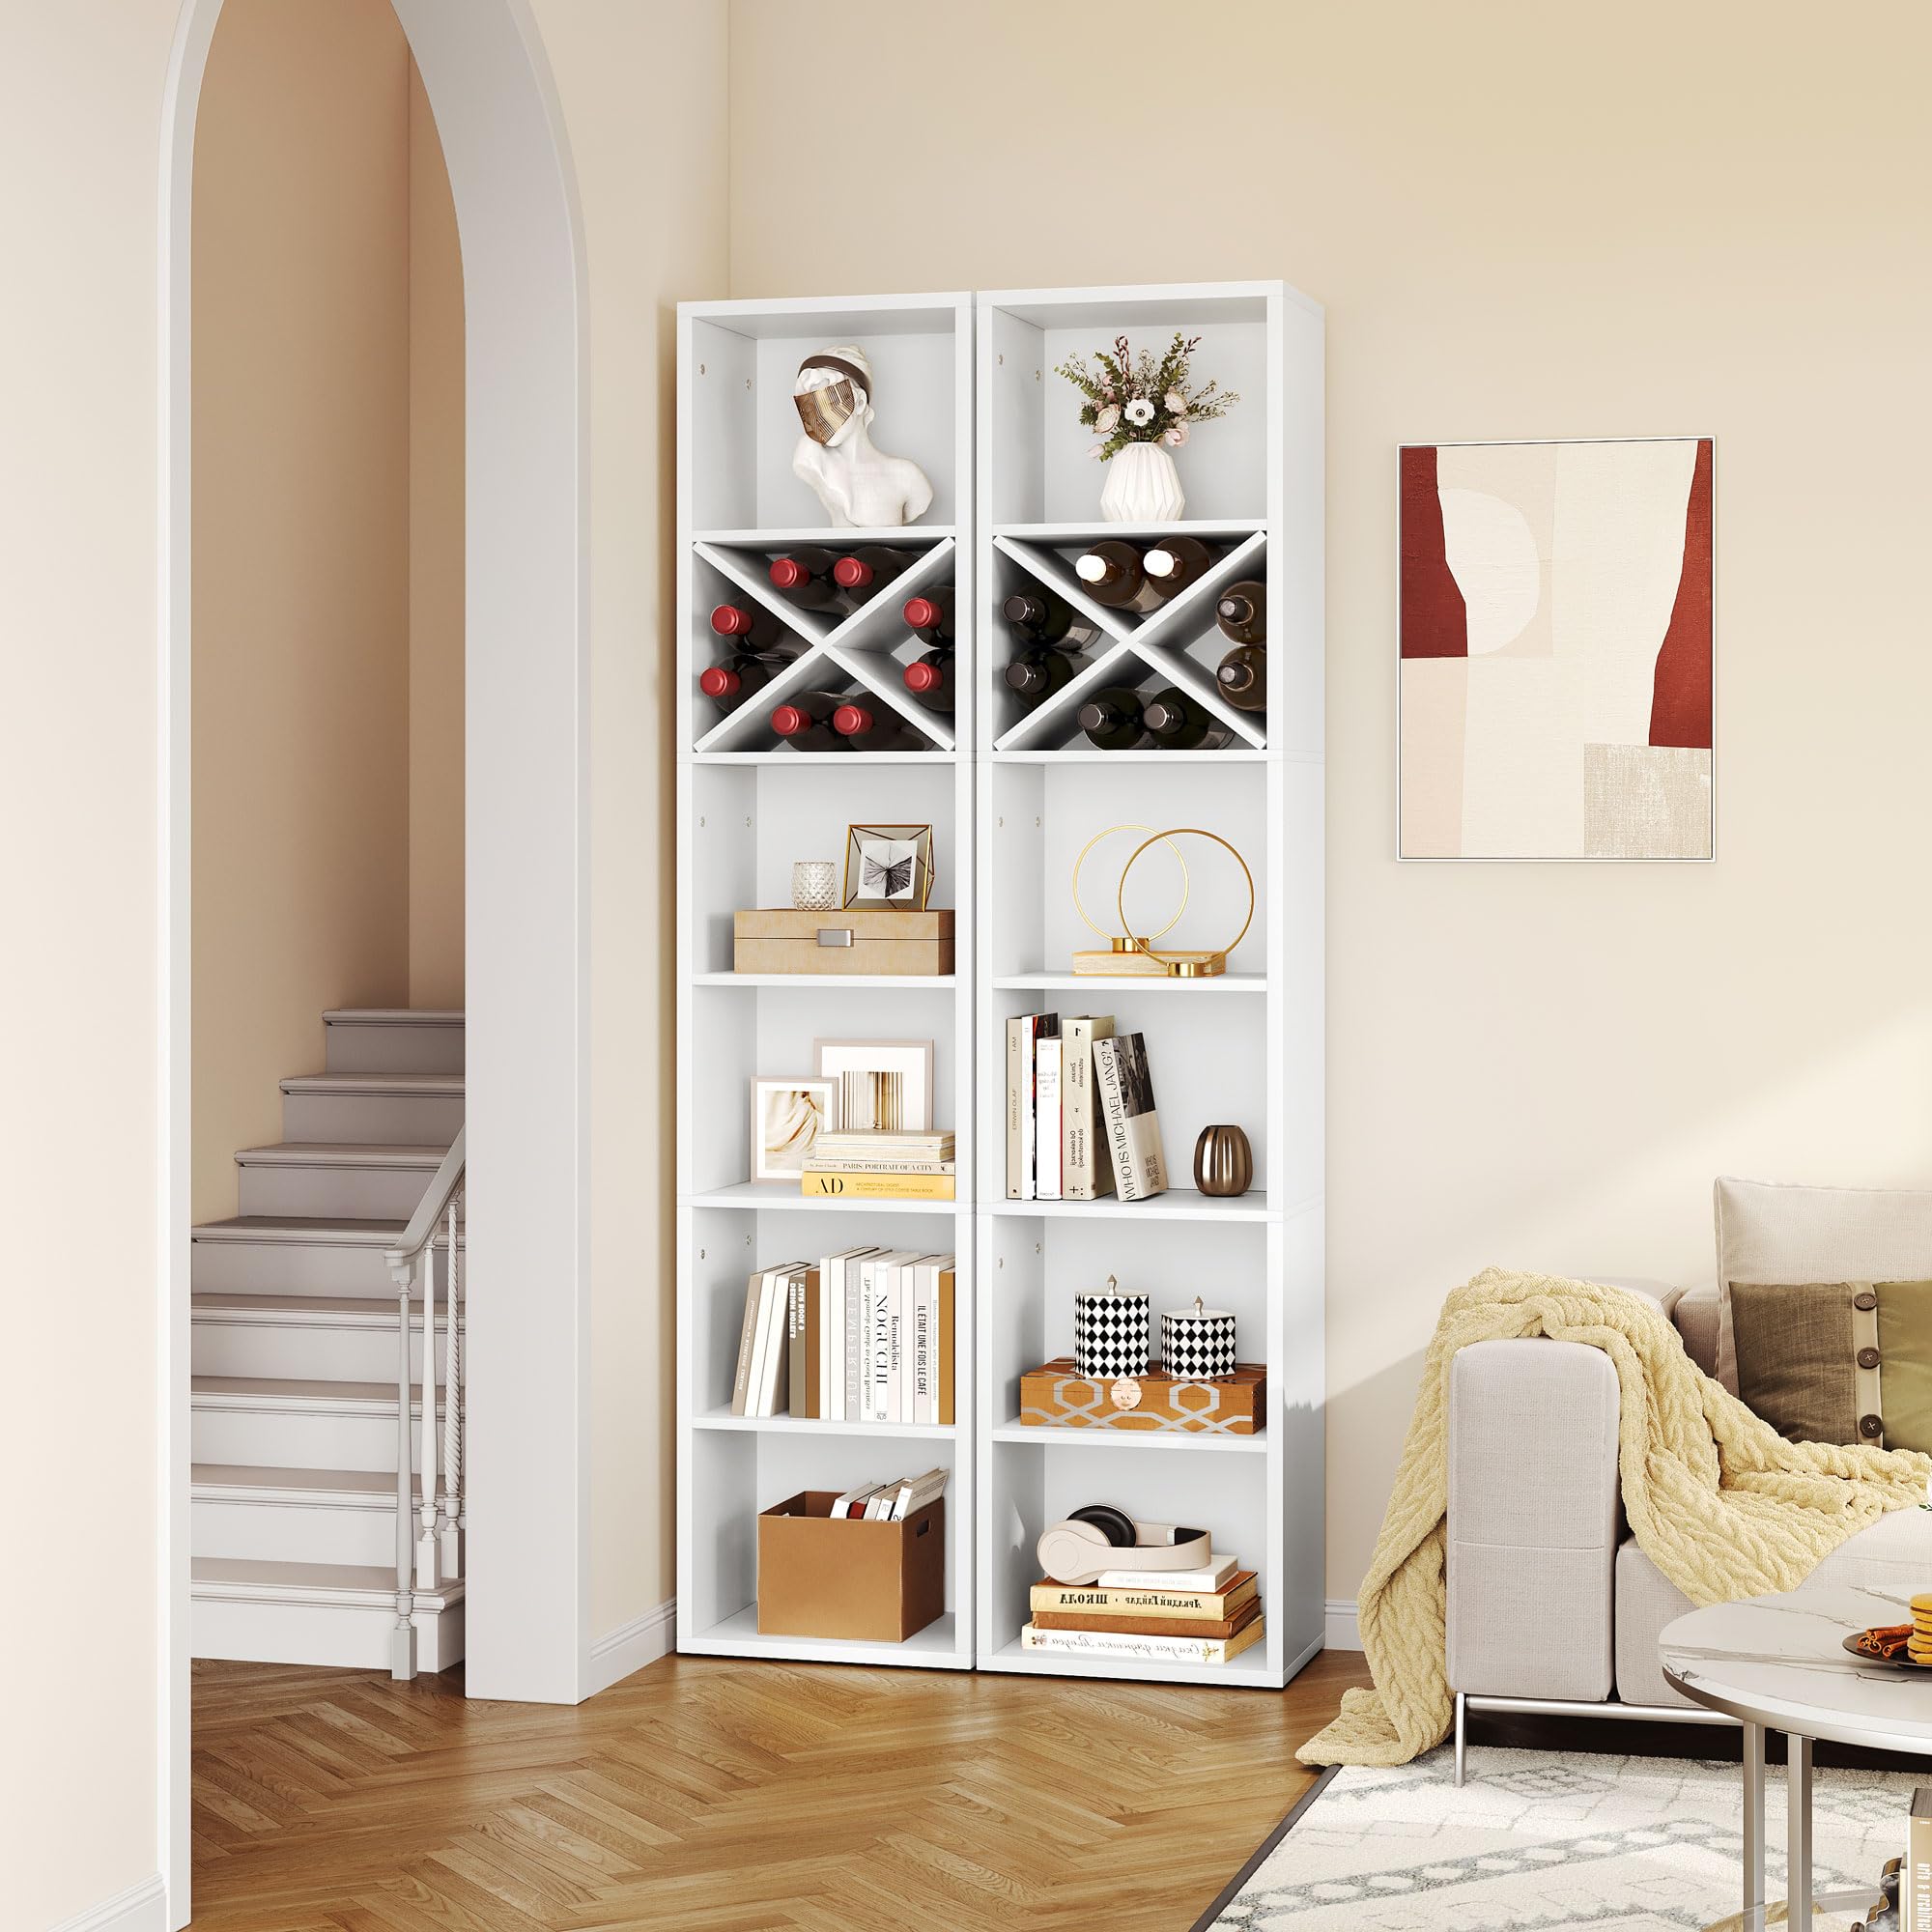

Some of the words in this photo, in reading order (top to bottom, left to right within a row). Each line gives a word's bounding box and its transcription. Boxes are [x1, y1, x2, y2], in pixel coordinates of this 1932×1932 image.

[1100, 1051, 1118, 1091] JANG?
[1107, 1092, 1127, 1150] MICHAEL
[1119, 1151, 1129, 1164] IS
[815, 1178, 844, 1194] AD
[1121, 1165, 1136, 1200] WHO
[918, 1313, 927, 1333] ÉTAIT
[875, 1294, 887, 1383] NOGUCHI
[891, 1315, 900, 1372] Remodelista
[918, 1334, 927, 1349] UNE
[918, 1350, 927, 1366] FOIS
[918, 1378, 927, 1395] CAFÉ
[1917, 1862, 1932, 1880] arts
